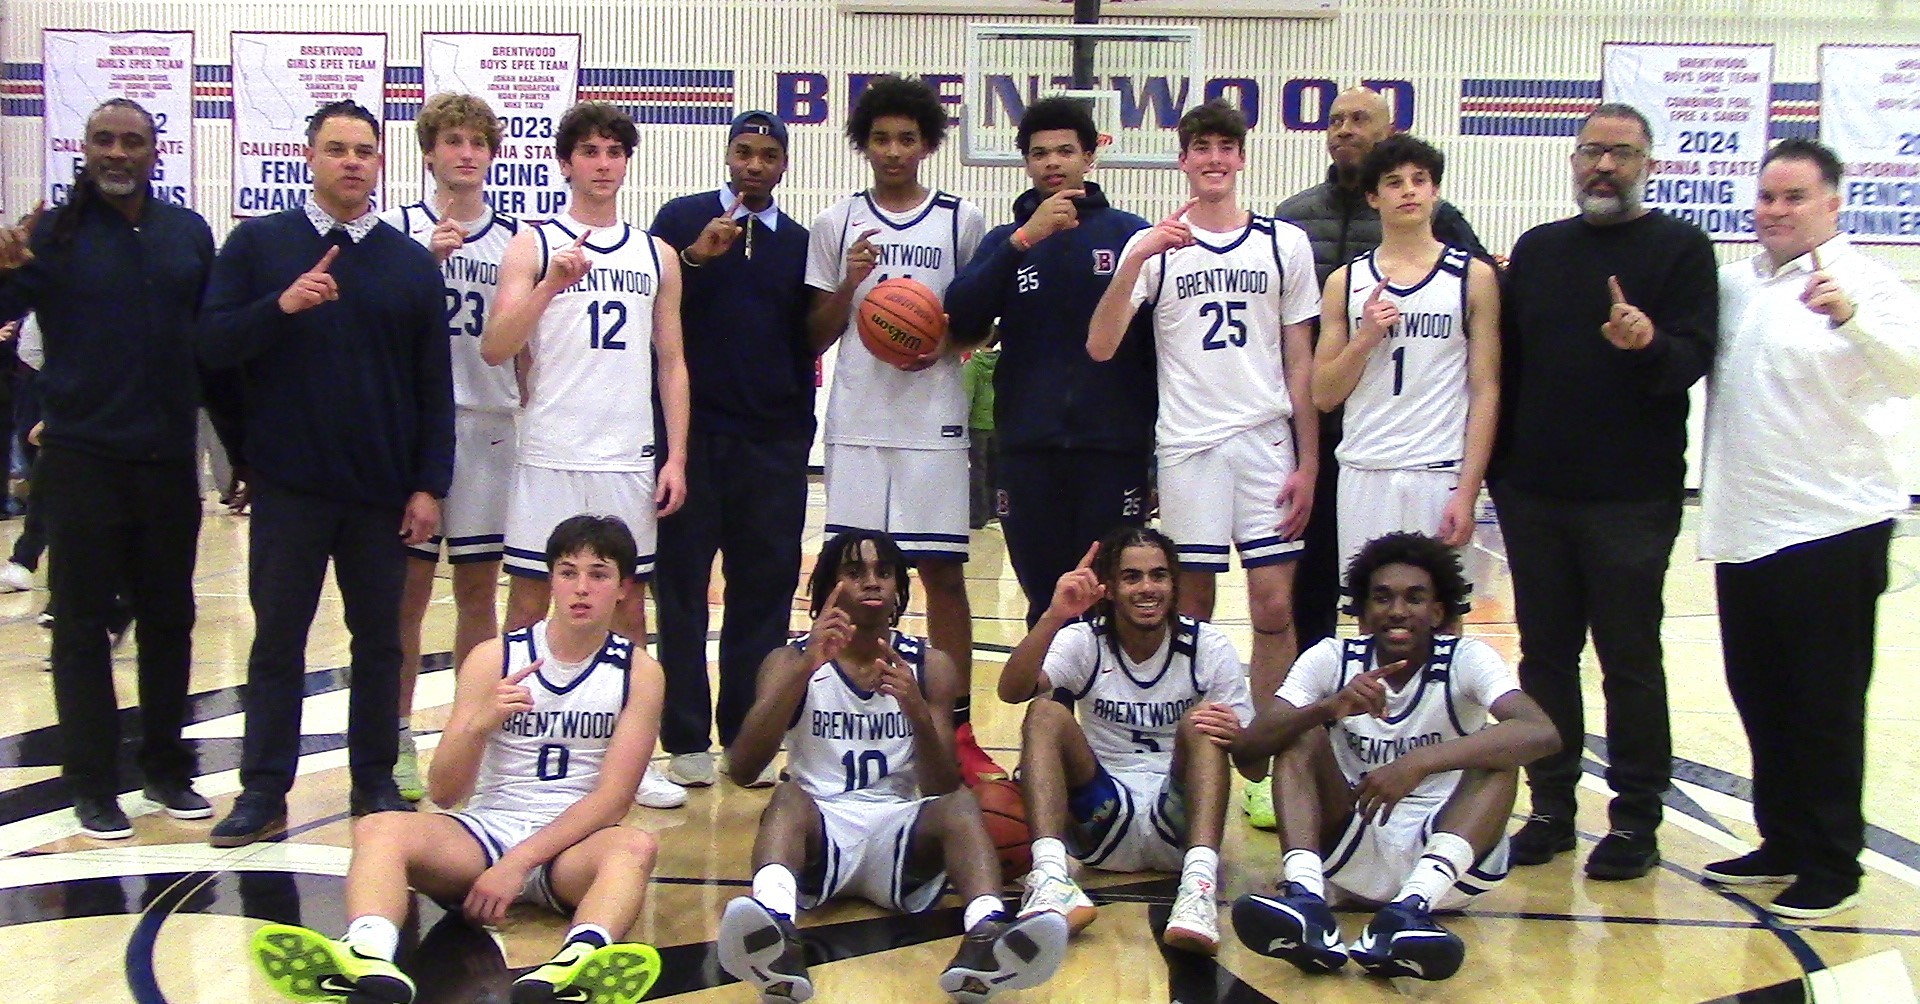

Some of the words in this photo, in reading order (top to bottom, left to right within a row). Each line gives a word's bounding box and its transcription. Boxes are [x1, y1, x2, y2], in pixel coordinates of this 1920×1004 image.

[300, 46, 363, 56] BRENTWOOD
[492, 47, 556, 57] BRENTWOOD
[286, 58, 317, 69] GIRLS
[320, 59, 344, 69] EPEE
[347, 60, 376, 70] TEAM
[480, 59, 507, 70] BOYS
[511, 60, 535, 70] EPEE
[539, 60, 568, 70] TEAM
[496, 116, 552, 138] 2023
[240, 141, 307, 156] CALIFOR
[524, 145, 557, 159] STA
[1678, 131, 1740, 153] 2024
[261, 161, 314, 183] FENC
[484, 163, 548, 186] CING
[482, 190, 526, 214] NER
[536, 191, 567, 214] UP
[1642, 179, 1734, 203] ENCING
[876, 243, 942, 270] NTWOOD
[557, 268, 652, 296] ENTWOOD
[1016, 271, 1040, 294] 25
[1175, 267, 1268, 298] BRENTWOOD
[444, 288, 485, 337] 23
[587, 300, 627, 351] 12
[871, 313, 922, 351] Wilson
[1199, 300, 1248, 351] 25
[1392, 346, 1405, 396] 1
[1122, 497, 1142, 516] 25
[841, 749, 888, 792] 10
